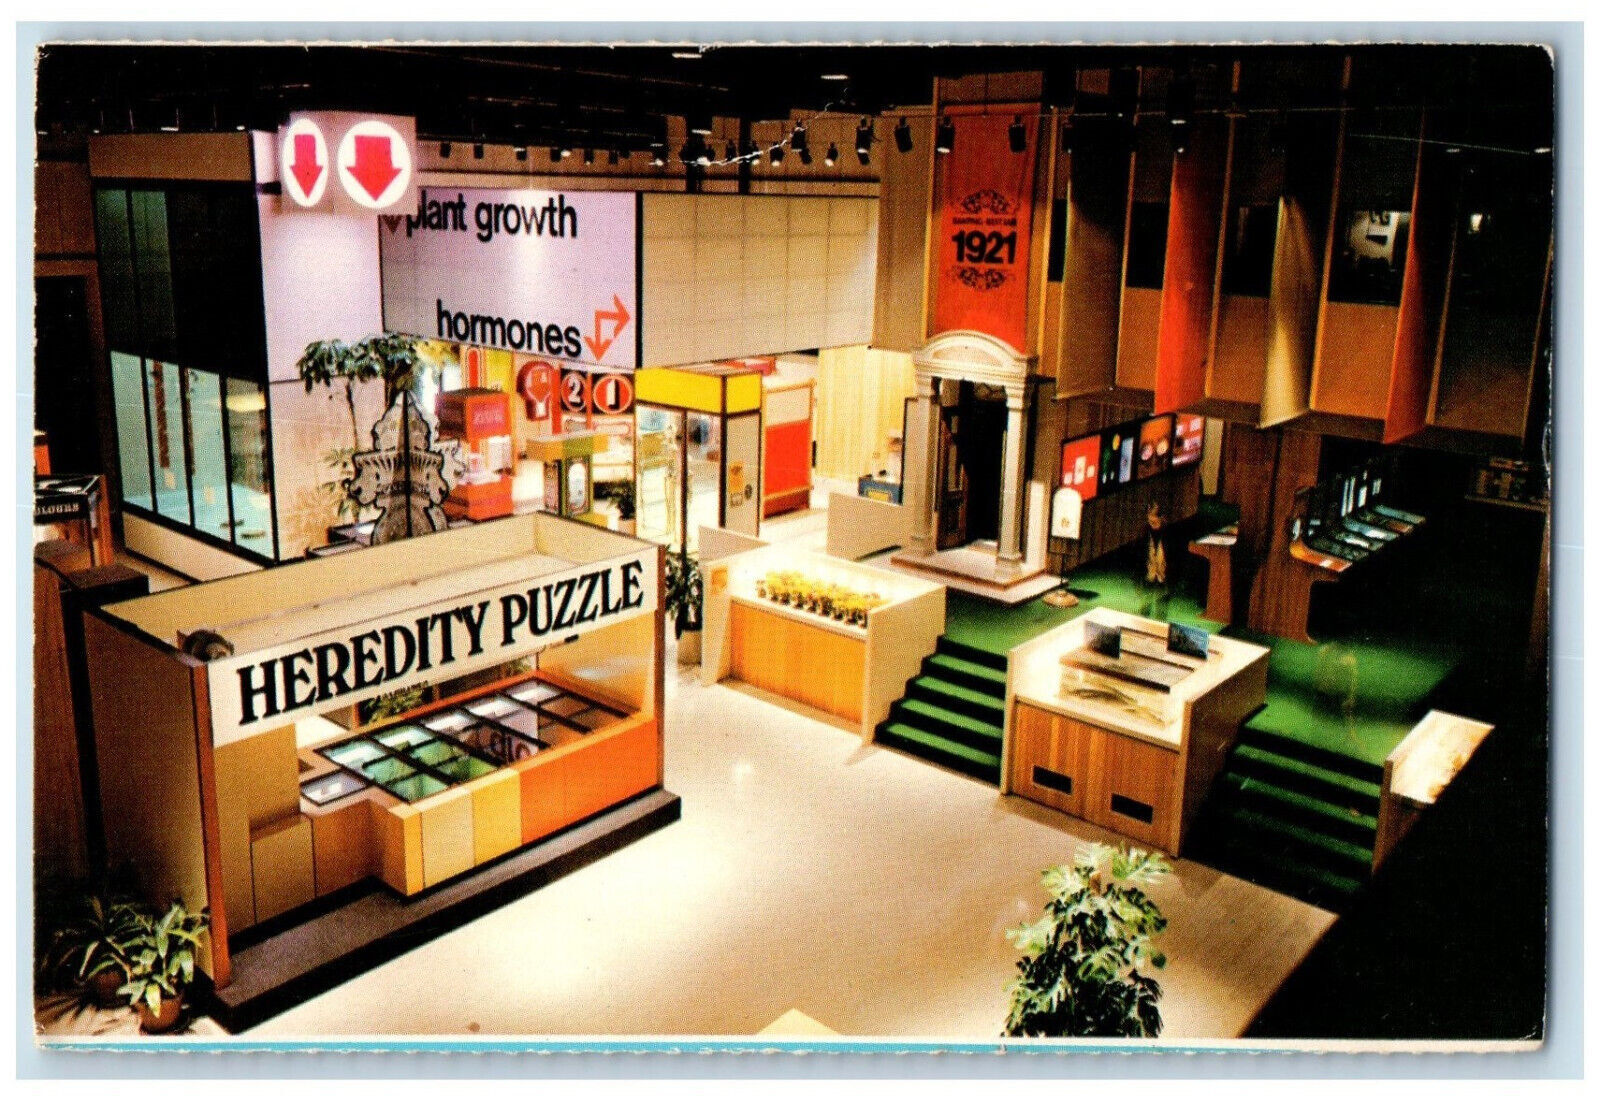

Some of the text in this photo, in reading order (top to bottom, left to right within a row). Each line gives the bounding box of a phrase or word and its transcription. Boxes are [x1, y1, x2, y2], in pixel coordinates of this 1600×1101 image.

[475, 194, 578, 242] growth
[952, 230, 1017, 264] 1921
[436, 299, 582, 358] hormones
[568, 374, 586, 406] 2
[237, 560, 645, 726] HEREDITY PUZZLE
